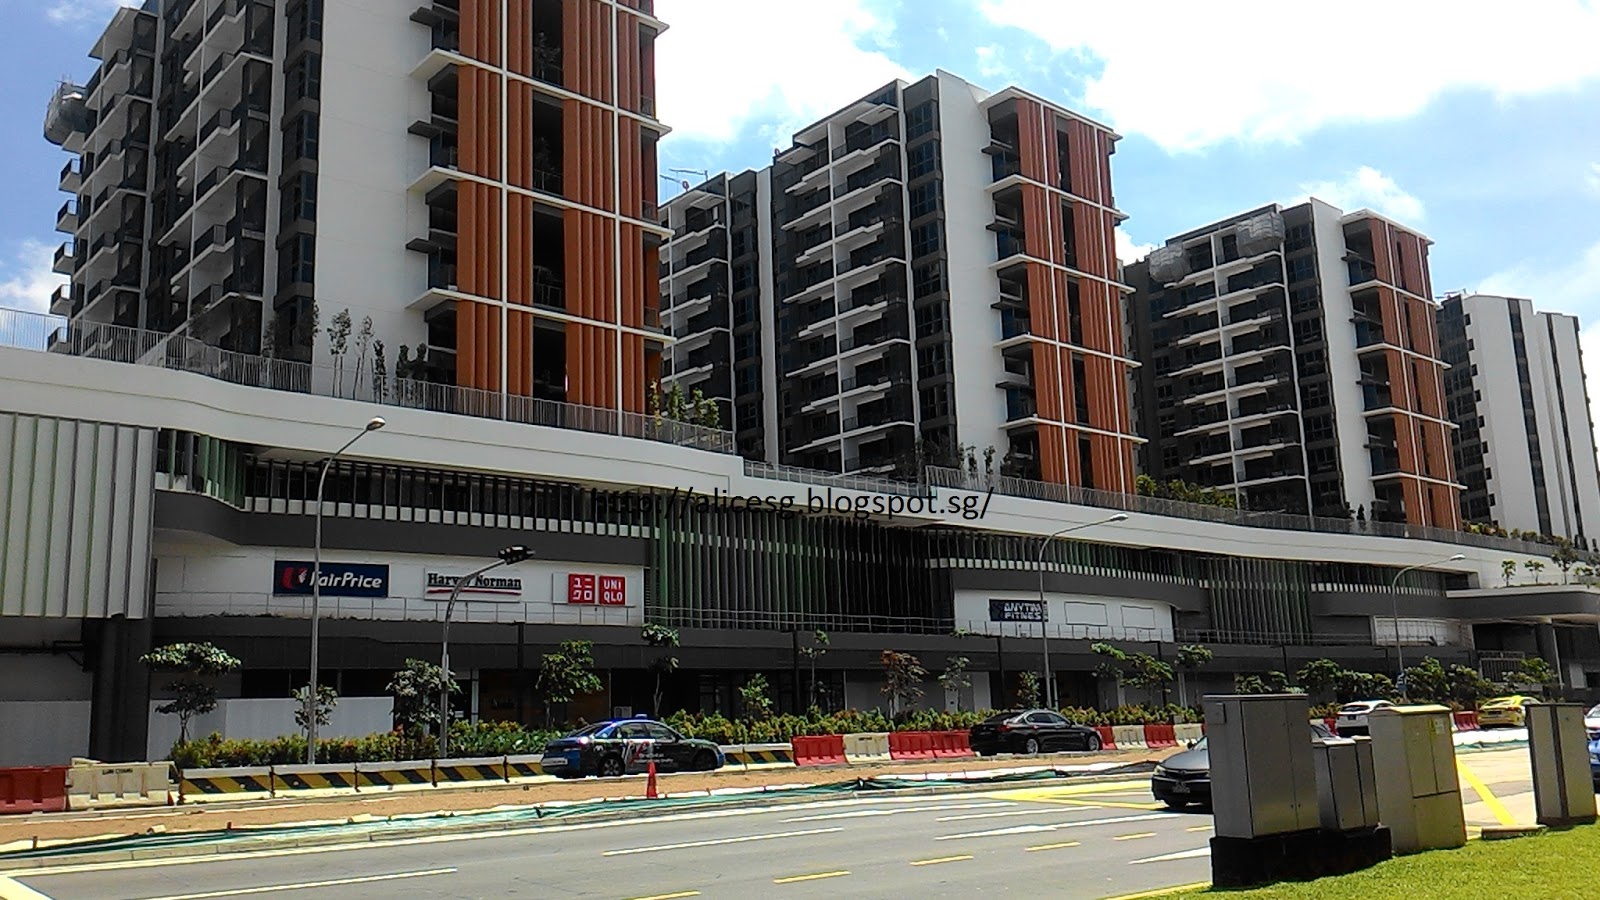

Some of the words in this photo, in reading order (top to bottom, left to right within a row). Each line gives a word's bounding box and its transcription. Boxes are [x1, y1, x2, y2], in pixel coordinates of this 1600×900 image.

[309, 571, 382, 588] FairPrice
[427, 572, 472, 588] Harvy
[475, 575, 522, 588] Norman
[603, 579, 622, 590] UNI
[603, 591, 623, 603] QLO
